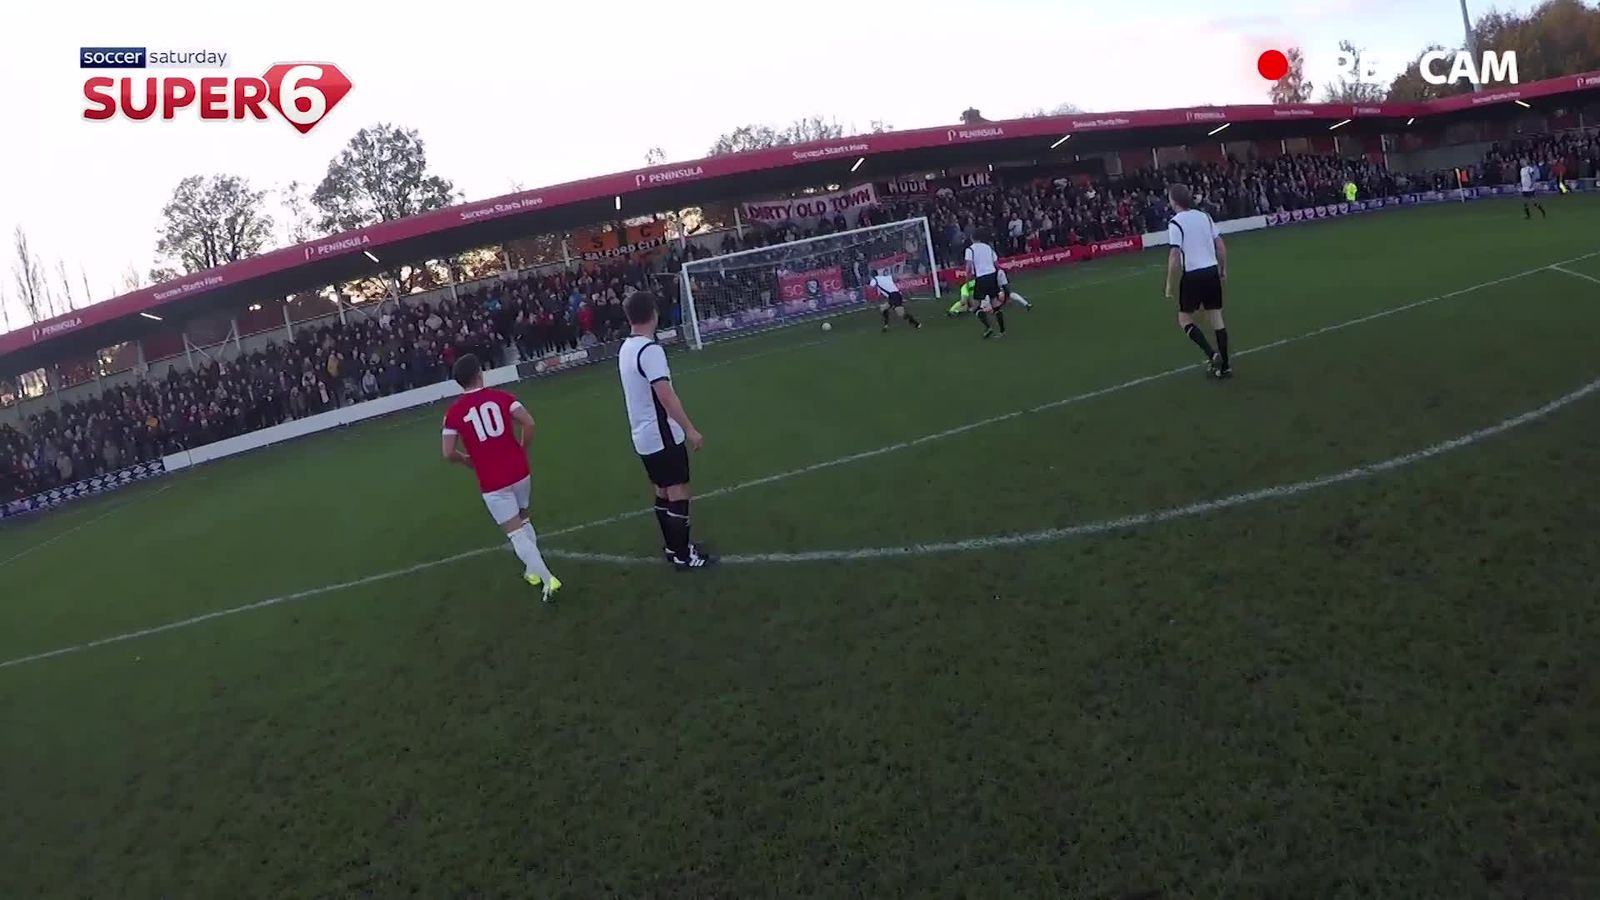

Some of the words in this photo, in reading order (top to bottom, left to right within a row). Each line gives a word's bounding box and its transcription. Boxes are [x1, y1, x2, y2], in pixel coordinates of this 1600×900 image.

[648, 165, 704, 183] PENINSULA
[960, 172, 992, 187] LANE
[747, 203, 792, 220] DIRTY
[796, 201, 827, 218] OLD
[830, 188, 871, 214] TOWN
[318, 234, 371, 255] PENINSULA
[583, 244, 636, 260] SALFORD
[637, 235, 667, 250] CITY
[463, 401, 506, 442] 10
